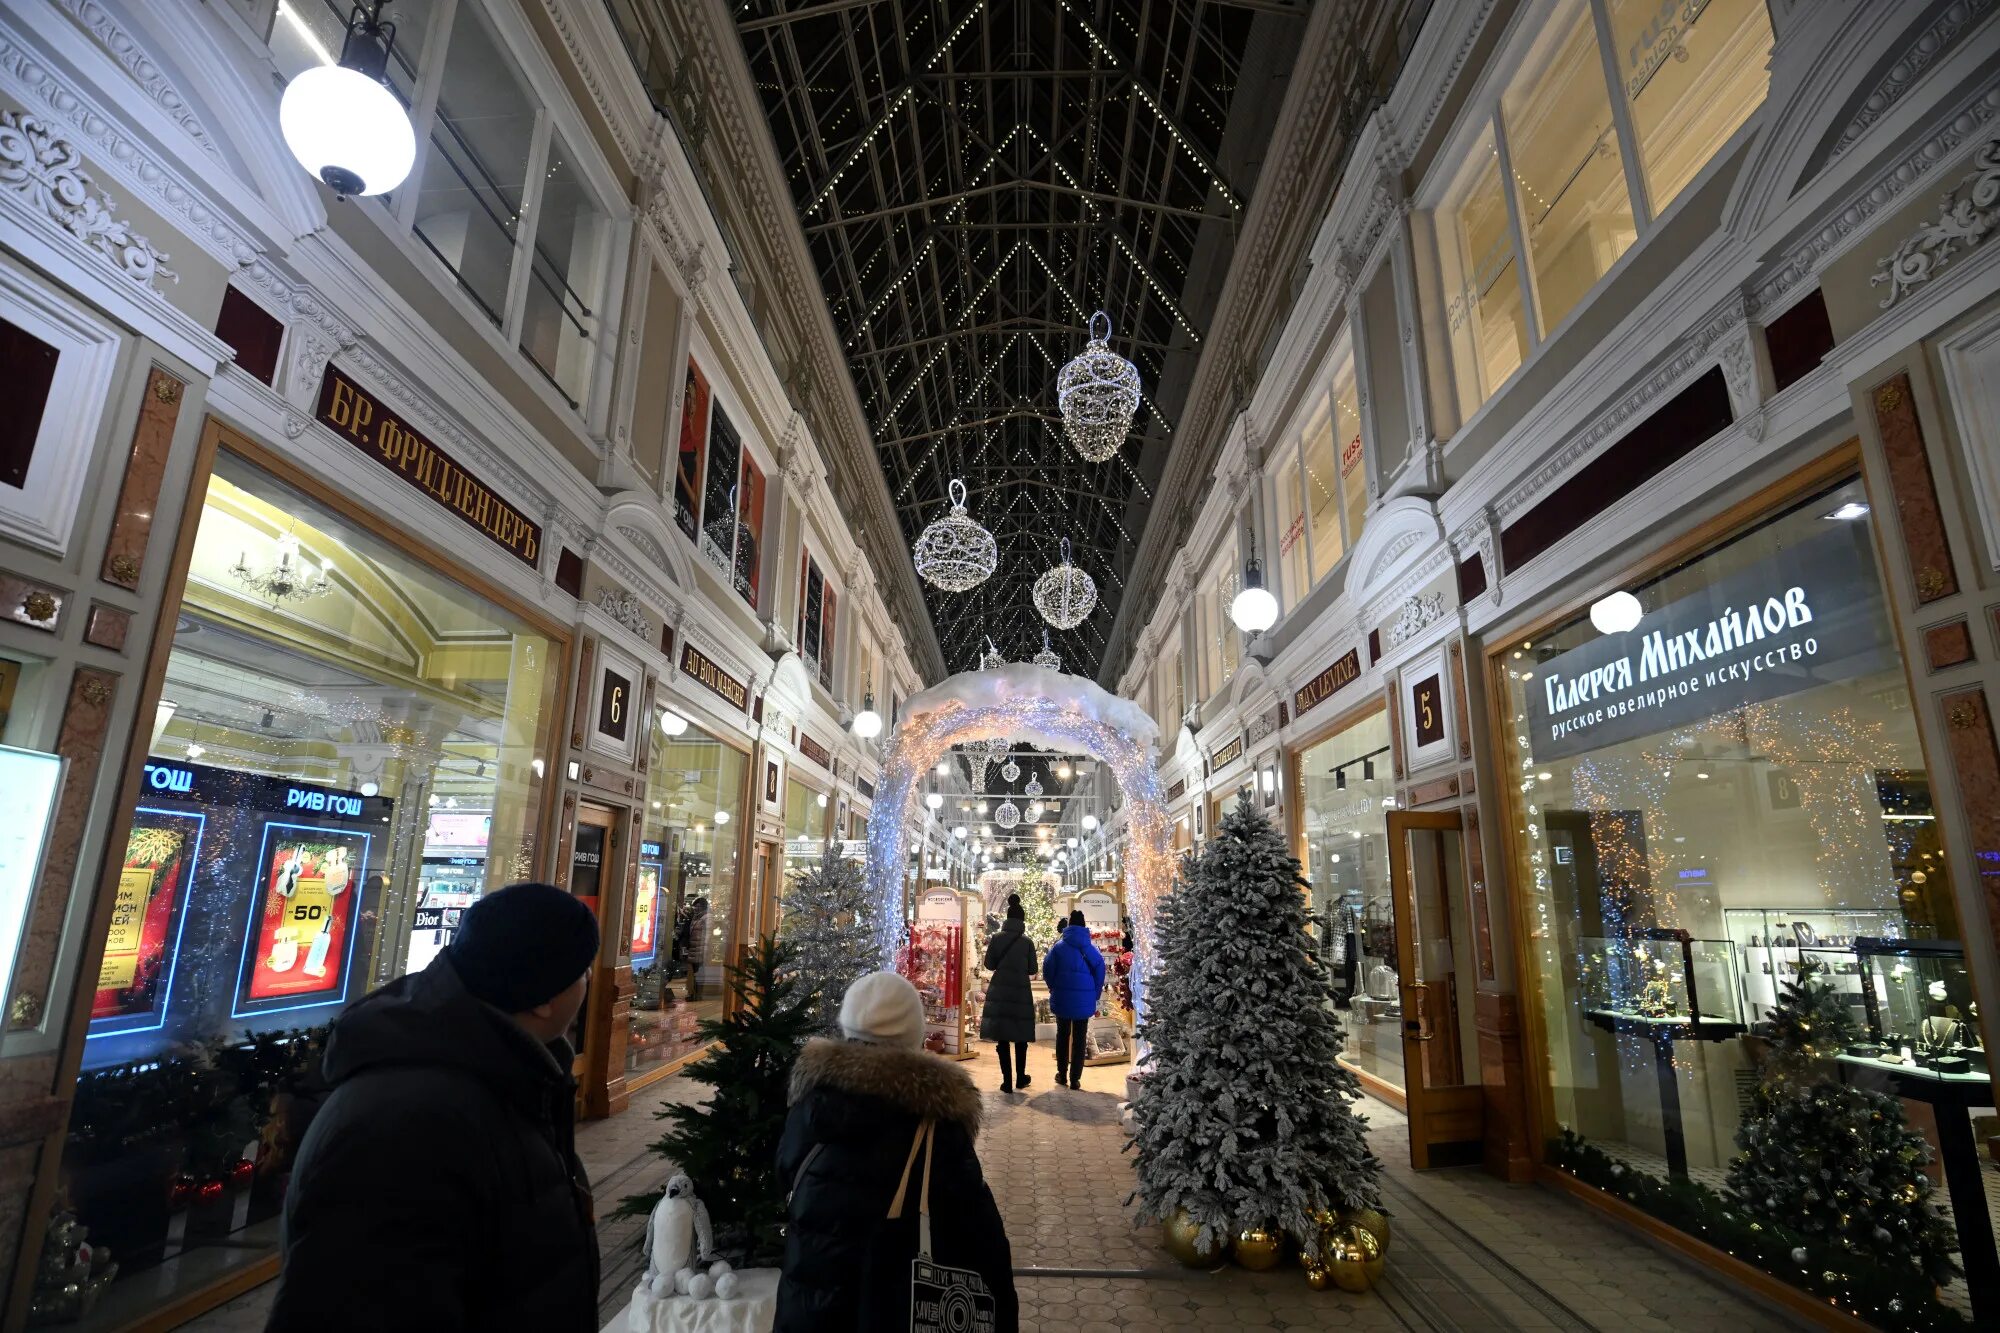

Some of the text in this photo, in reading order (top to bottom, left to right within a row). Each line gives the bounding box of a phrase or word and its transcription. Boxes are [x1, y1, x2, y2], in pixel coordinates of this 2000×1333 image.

[328, 377, 537, 560] БР. ФРИДЛЕНДЕРЪ
[1545, 587, 1813, 715] Галерея Михайлов
[686, 649, 699, 675] AU
[699, 657, 717, 687] BON
[1296, 681, 1318, 711] MAX
[1551, 637, 1818, 741] русское ювелирное искусство
[611, 686, 622, 723] 6
[1421, 691, 1433, 730] 5
[769, 770, 776, 793] 8
[286, 788, 363, 816] РИВ ГОШ
[574, 850, 600, 864] РИВ ГОШ
[415, 911, 439, 926] Dior
[934, 1269, 949, 1286] LIVE
[915, 1300, 932, 1321] SAVE
